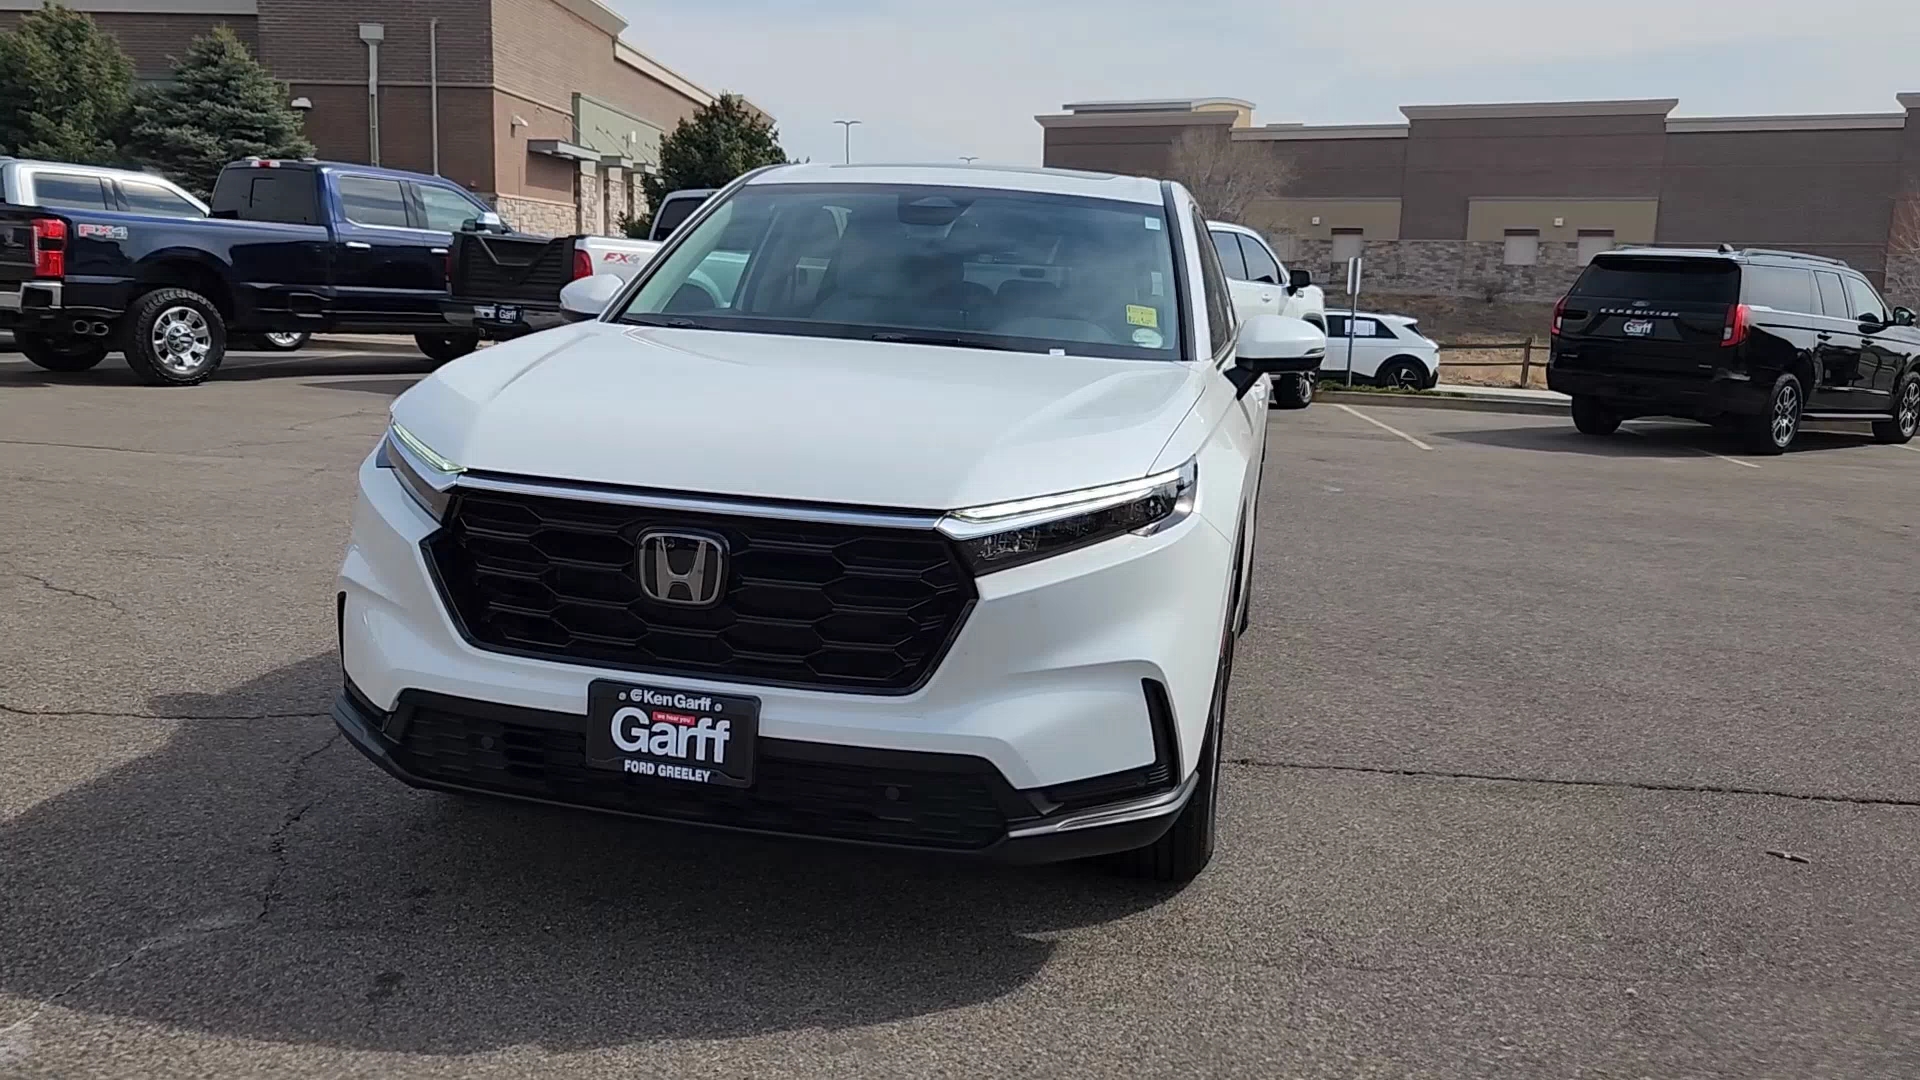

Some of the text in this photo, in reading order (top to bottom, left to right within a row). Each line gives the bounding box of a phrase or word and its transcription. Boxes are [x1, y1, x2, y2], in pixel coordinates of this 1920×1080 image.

[78, 223, 128, 239] FX4
[1600, 308, 1679, 316] EXPEDITION
[1623, 322, 1652, 333] Garff
[644, 690, 712, 711] Ken Garff
[611, 706, 731, 764] Garff
[624, 759, 711, 782] FORD GREELEY
